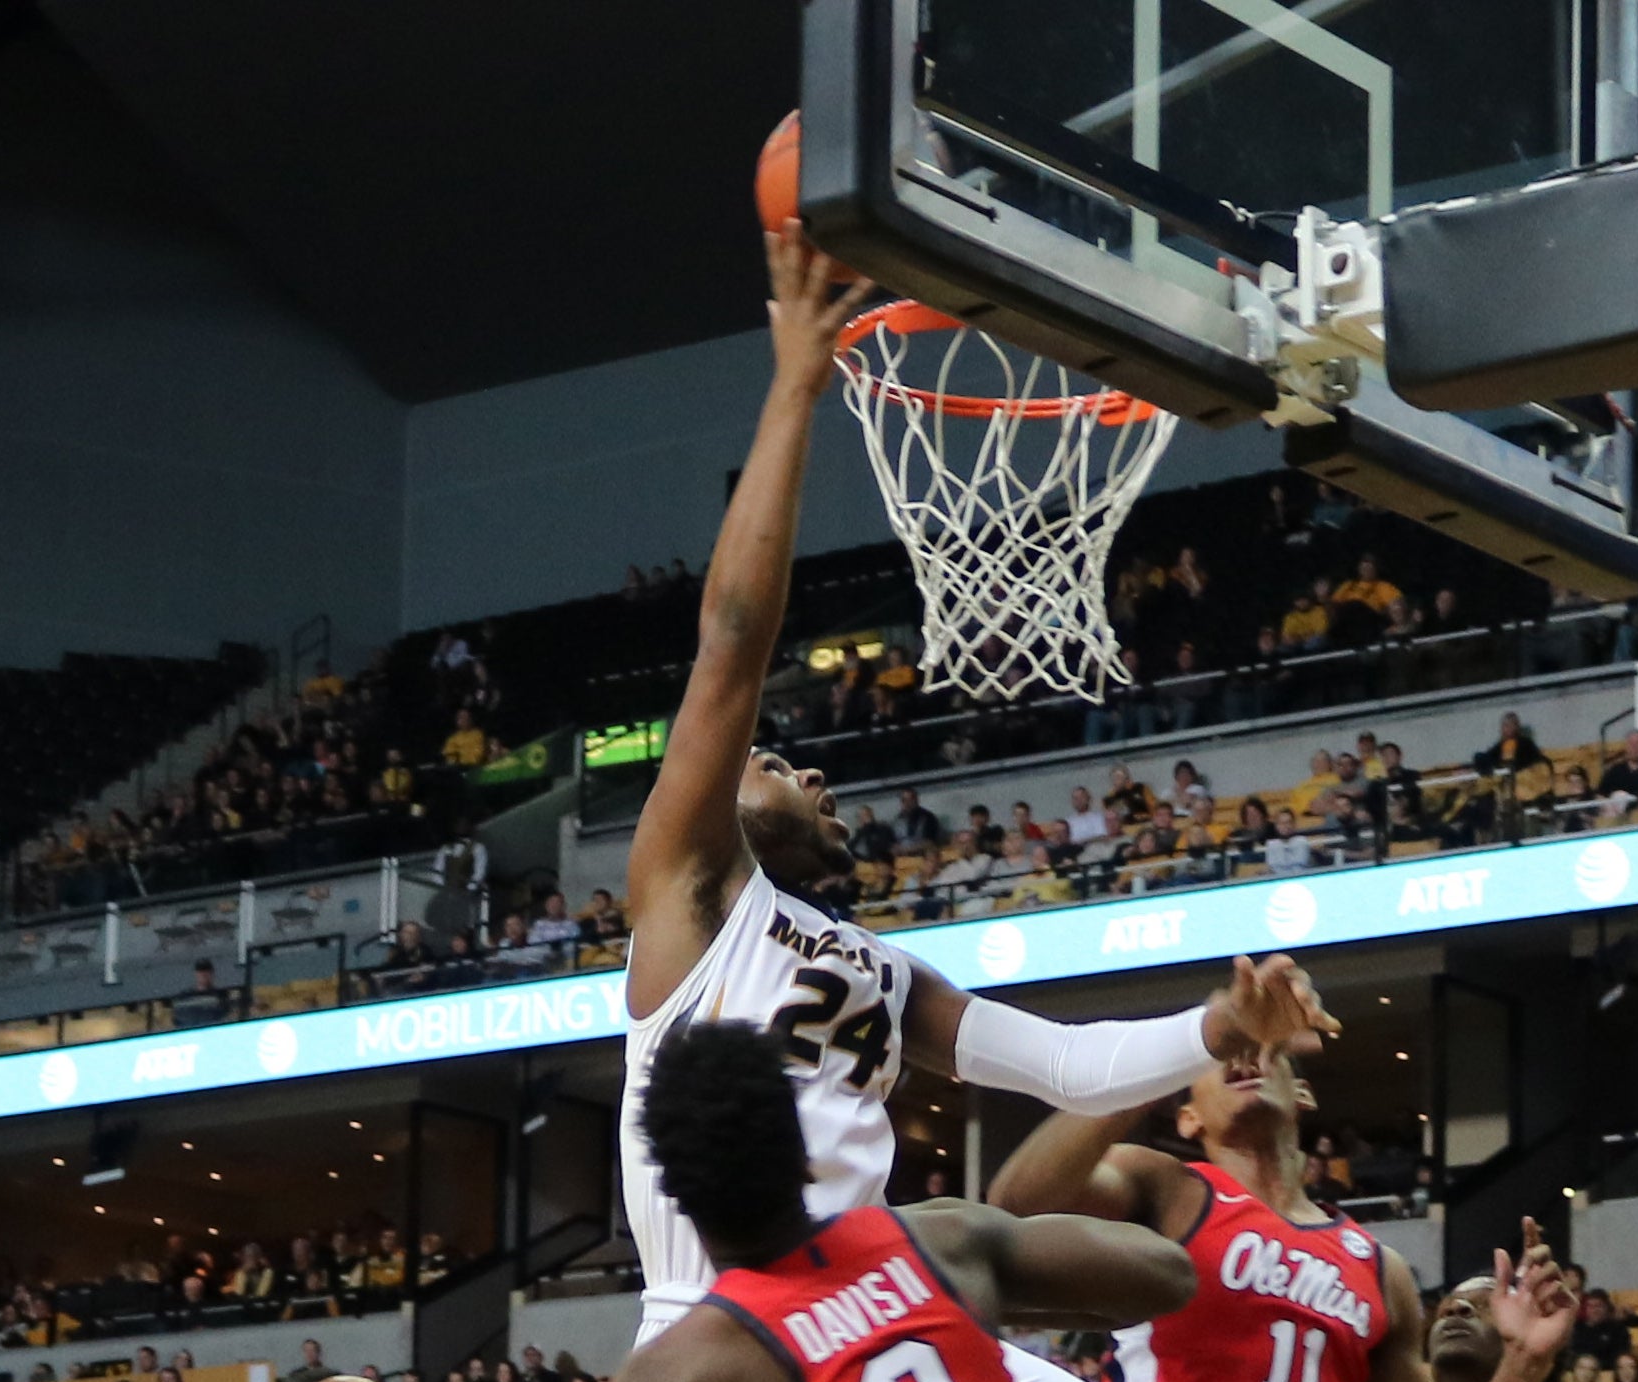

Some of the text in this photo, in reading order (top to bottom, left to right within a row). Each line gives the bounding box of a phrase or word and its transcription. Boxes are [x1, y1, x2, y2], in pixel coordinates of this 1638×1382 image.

[1100, 868, 1491, 954] AT&T AT&T
[131, 1043, 200, 1083] AT&T
[354, 984, 593, 1059] MOBILIZING
[767, 967, 893, 1090] 24
[782, 1271, 910, 1364] DAVIS
